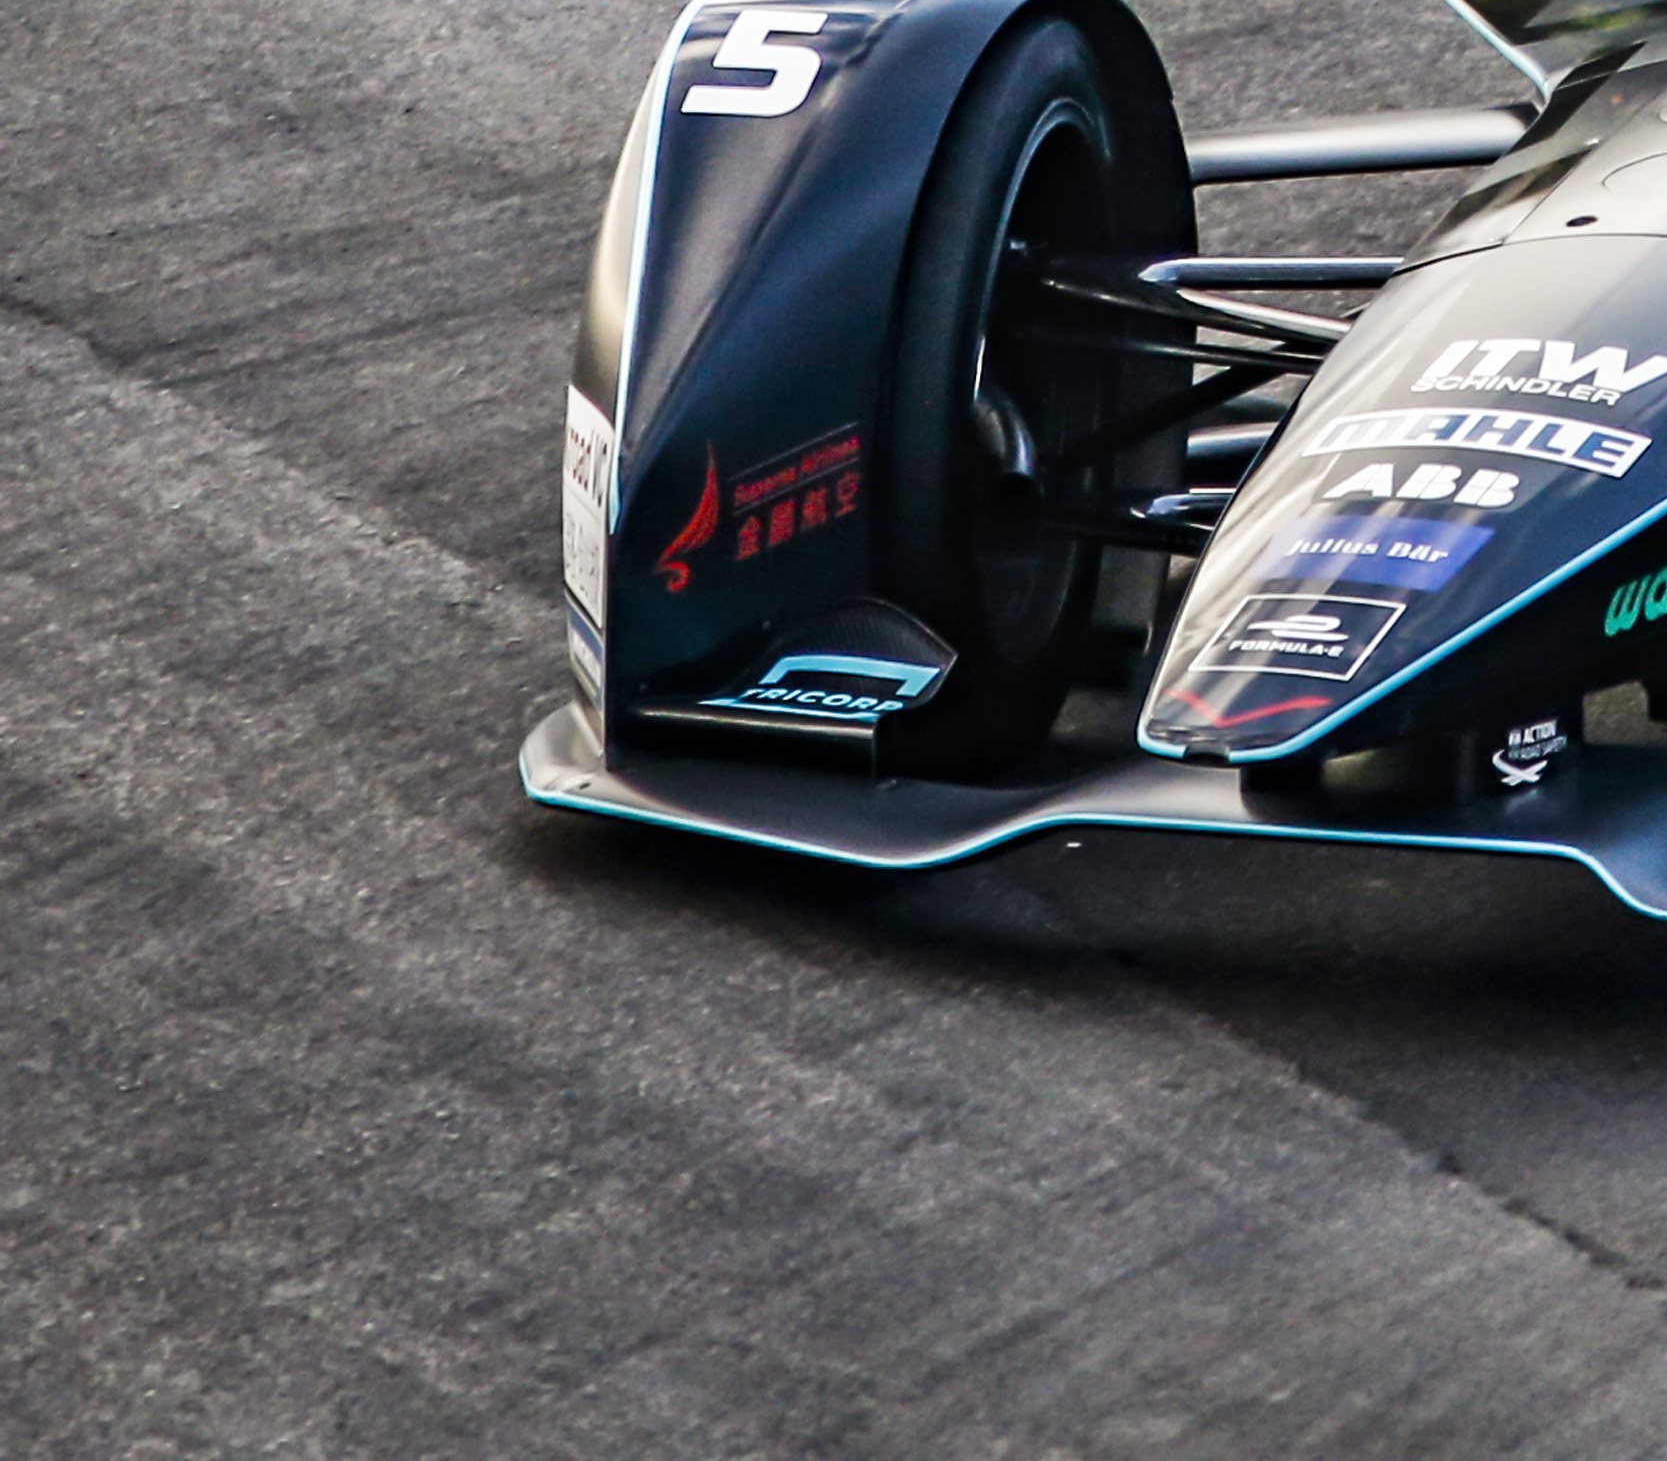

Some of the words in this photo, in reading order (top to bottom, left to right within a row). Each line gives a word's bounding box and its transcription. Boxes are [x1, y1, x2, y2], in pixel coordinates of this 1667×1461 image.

[680, 9, 829, 118] 5
[1411, 374, 1624, 407] SCHINDLER
[1318, 413, 1637, 469] MAHLE
[1322, 463, 1521, 509] ABB
[1284, 538, 1380, 558] Julius
[1386, 541, 1450, 564] Bär
